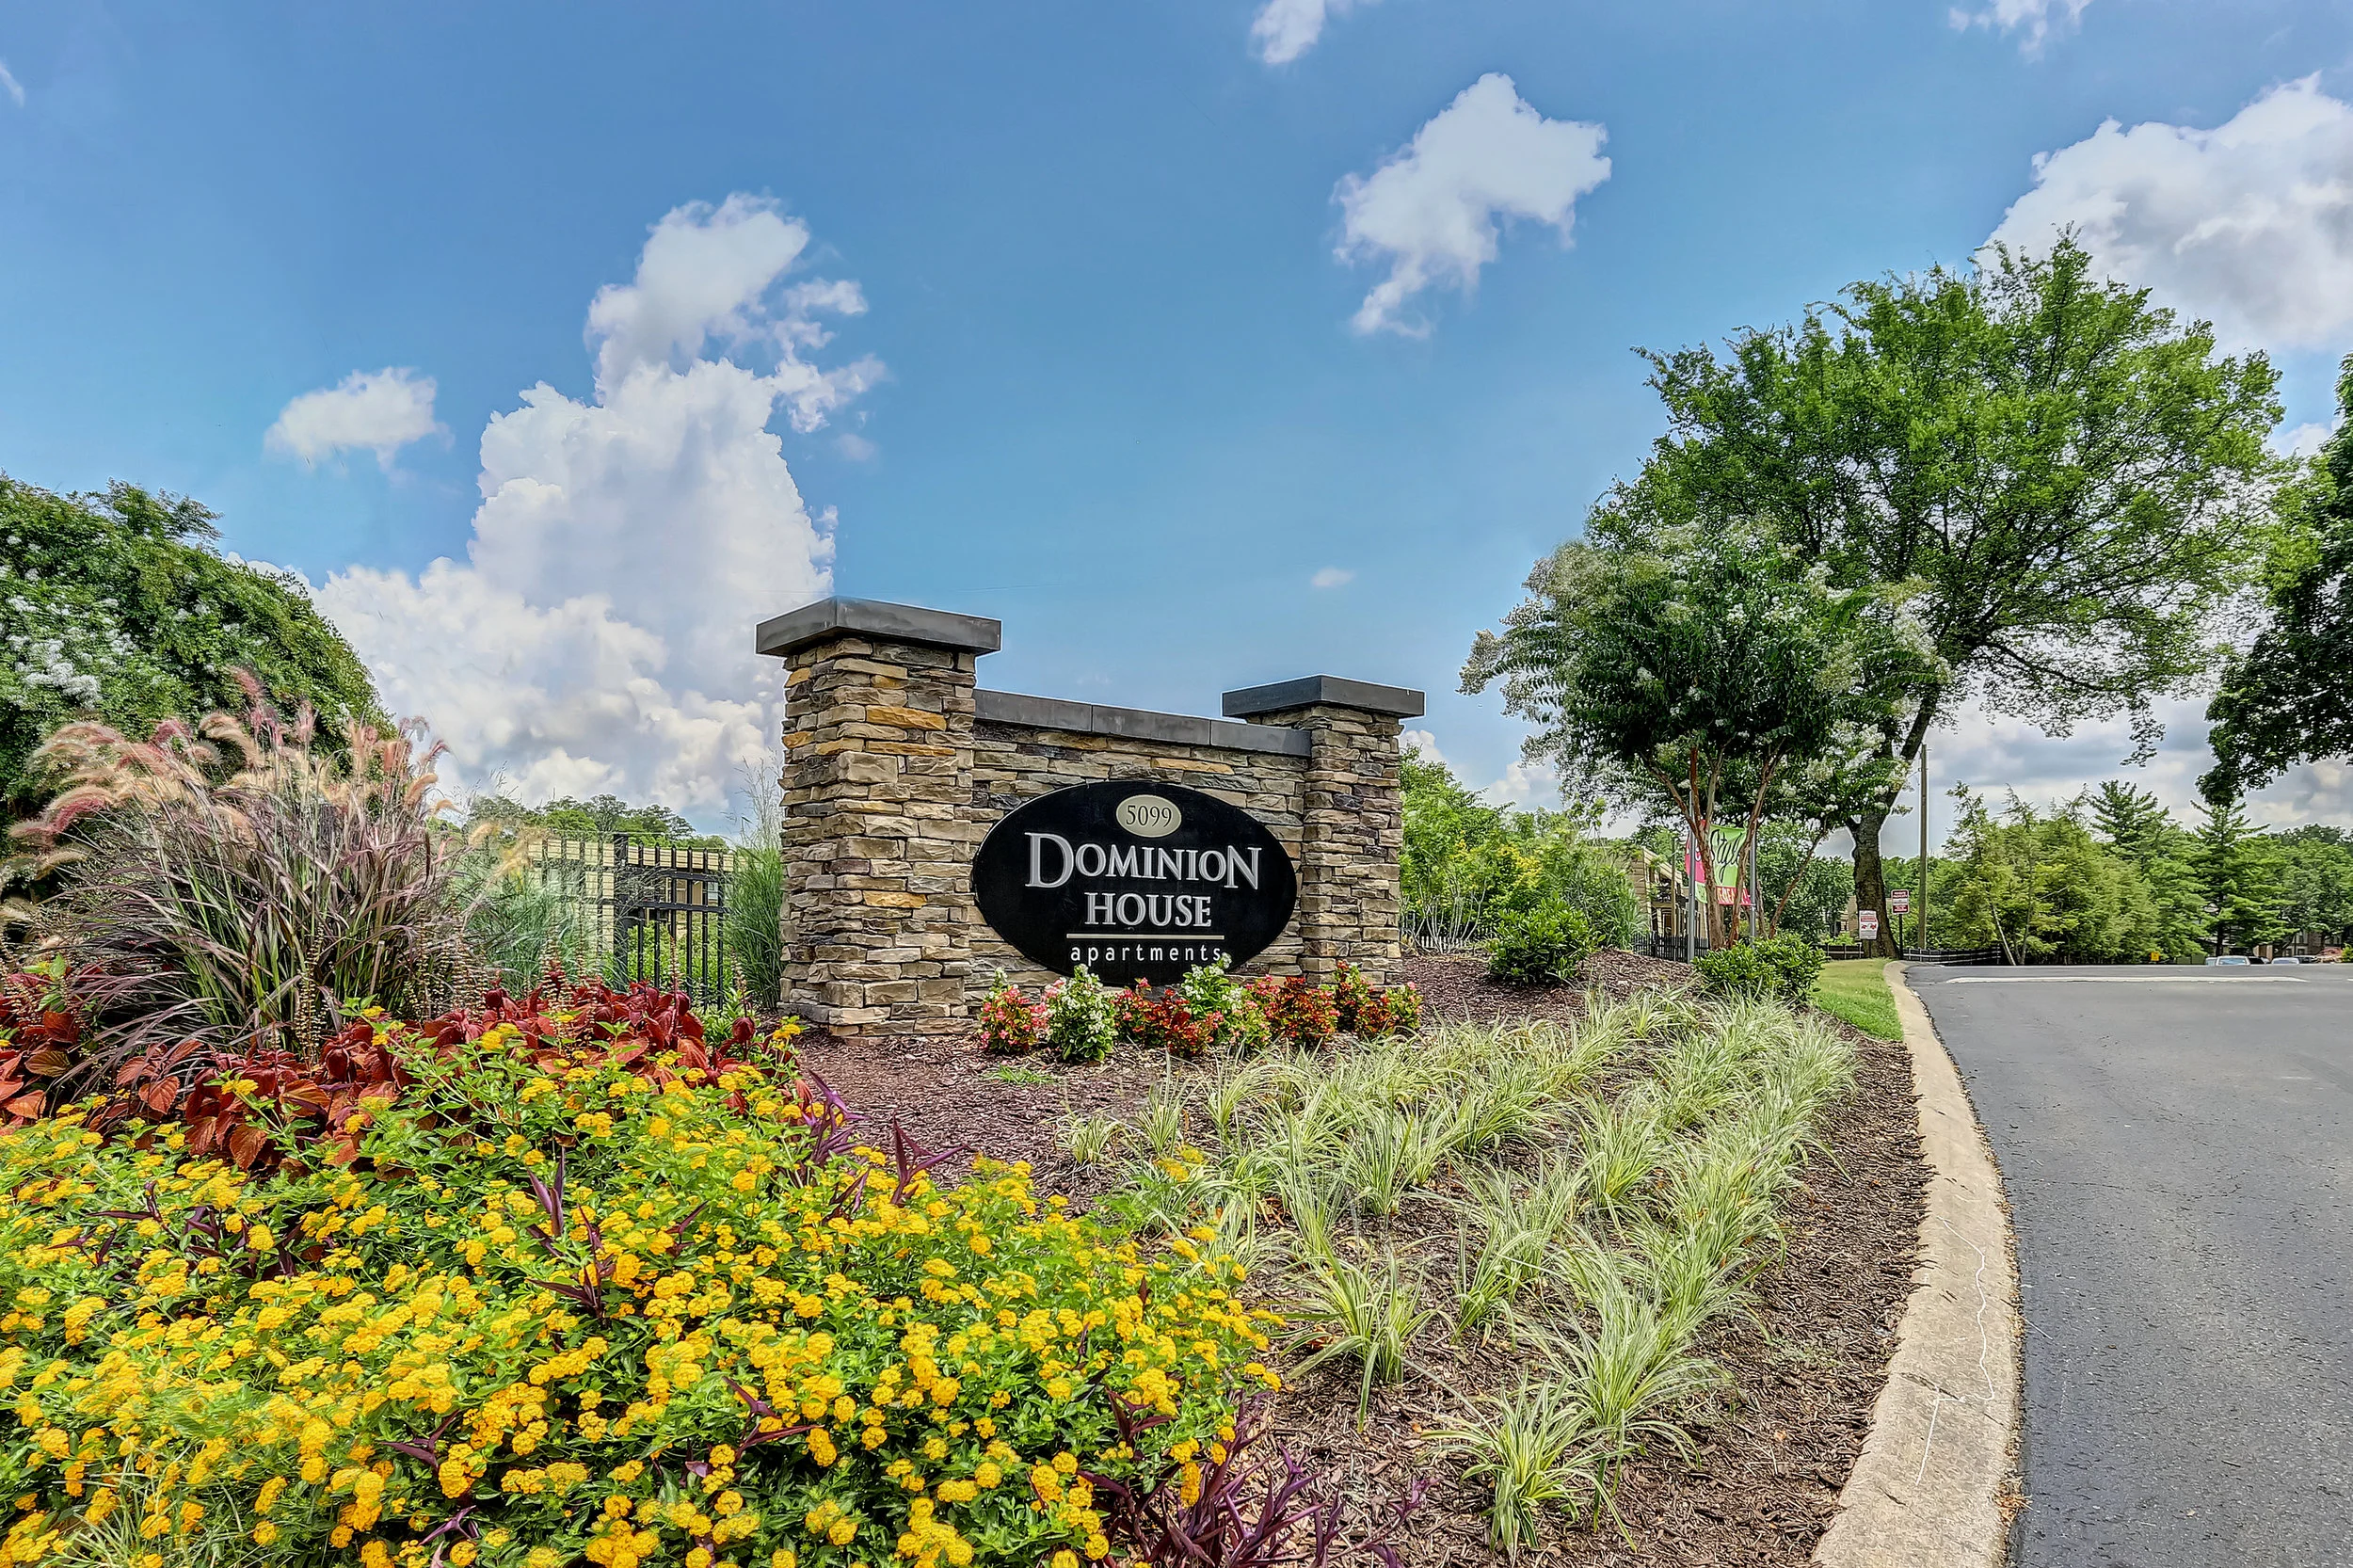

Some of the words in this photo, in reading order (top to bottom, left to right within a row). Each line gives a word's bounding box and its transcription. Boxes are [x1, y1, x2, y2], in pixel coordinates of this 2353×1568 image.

[1126, 805, 1173, 828] 5099
[1024, 831, 1263, 890] DOMINION
[1083, 891, 1213, 927] HOUSE
[1070, 944, 1222, 967] apartments
